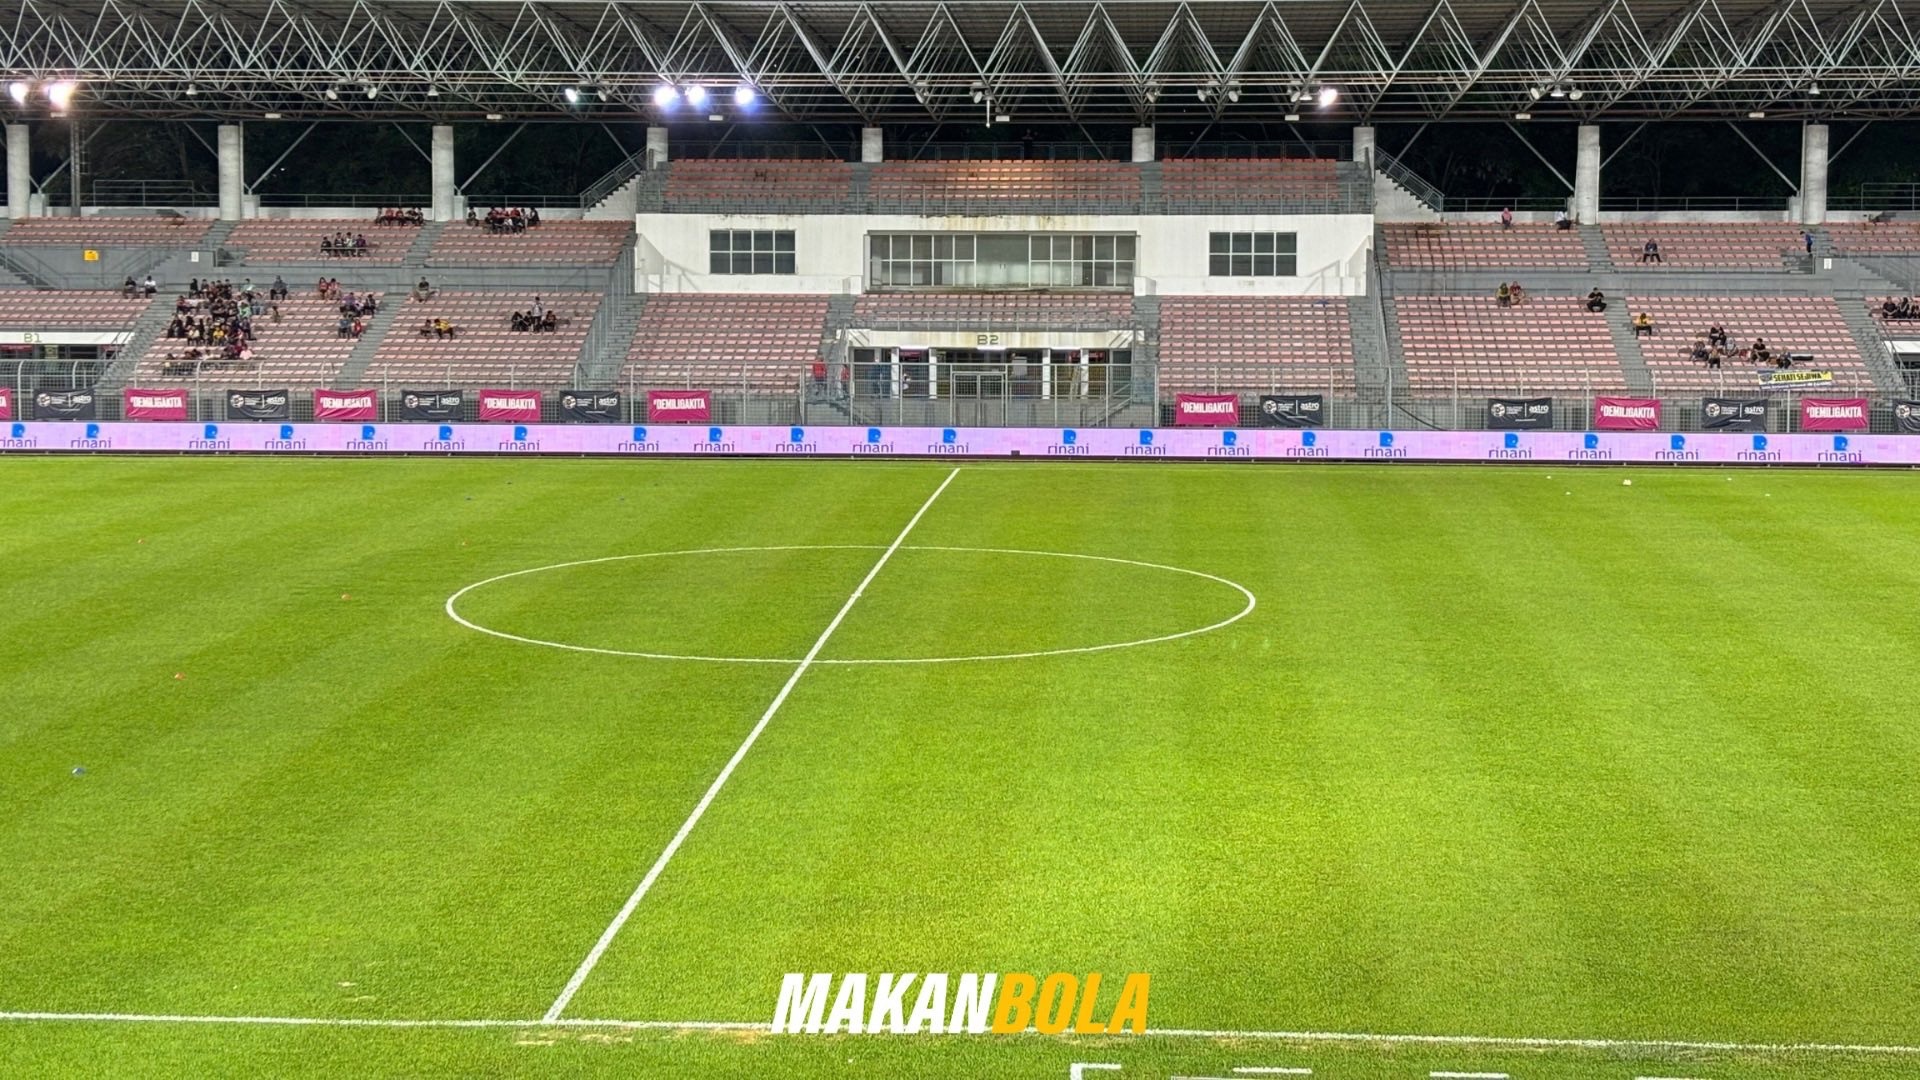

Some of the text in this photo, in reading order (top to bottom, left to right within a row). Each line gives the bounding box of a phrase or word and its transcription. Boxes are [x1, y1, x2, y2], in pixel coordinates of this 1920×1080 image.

[24, 333, 43, 343] B1
[977, 334, 999, 345] B2
[70, 437, 112, 448] rinani
[189, 437, 231, 449] rinani
[264, 438, 306, 450] rinani
[346, 438, 388, 450] rinani
[423, 438, 465, 450] rinani
[499, 439, 540, 451] rinani
[618, 440, 659, 451] rinani
[694, 441, 735, 453] rinani
[775, 441, 817, 453] rinani
[852, 441, 894, 453] rinani
[928, 442, 969, 453] rinani
[1047, 442, 1089, 454] rinani
[1124, 443, 1166, 455] rinani
[1207, 444, 1250, 456] rinani
[1286, 445, 1329, 457] rinani
[1364, 445, 1407, 457] rinani
[1489, 447, 1532, 459] rinani
[1568, 448, 1612, 460] rinani
[1655, 448, 1699, 460] rinani
[1737, 449, 1781, 461] rinani
[1818, 450, 1862, 462] rinani
